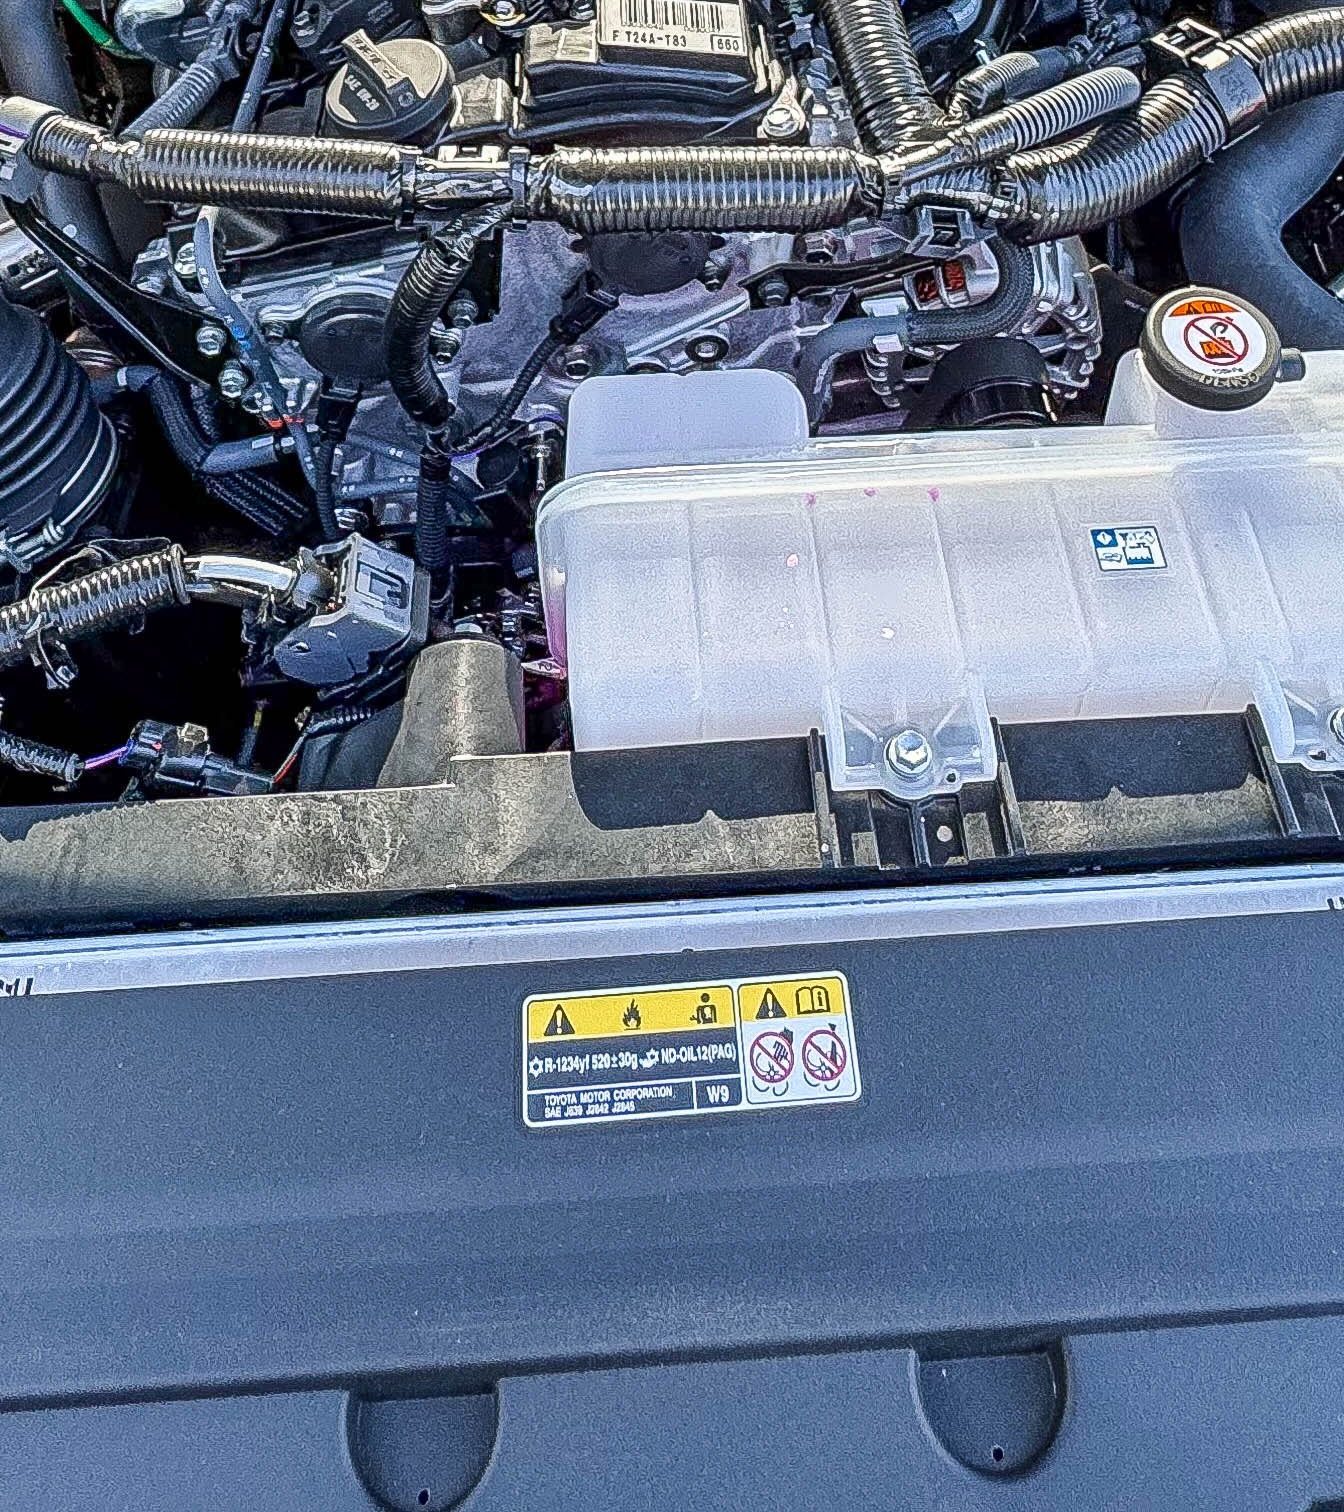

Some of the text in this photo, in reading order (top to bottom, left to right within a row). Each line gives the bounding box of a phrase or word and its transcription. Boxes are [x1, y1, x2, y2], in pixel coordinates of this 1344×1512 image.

[612, 29, 687, 48] F T24A-T83
[544, 1054, 590, 1074] R-1234yf
[544, 1084, 673, 1107] TOYOTA MOTOR CORPORATION
[707, 1085, 730, 1104] W9
